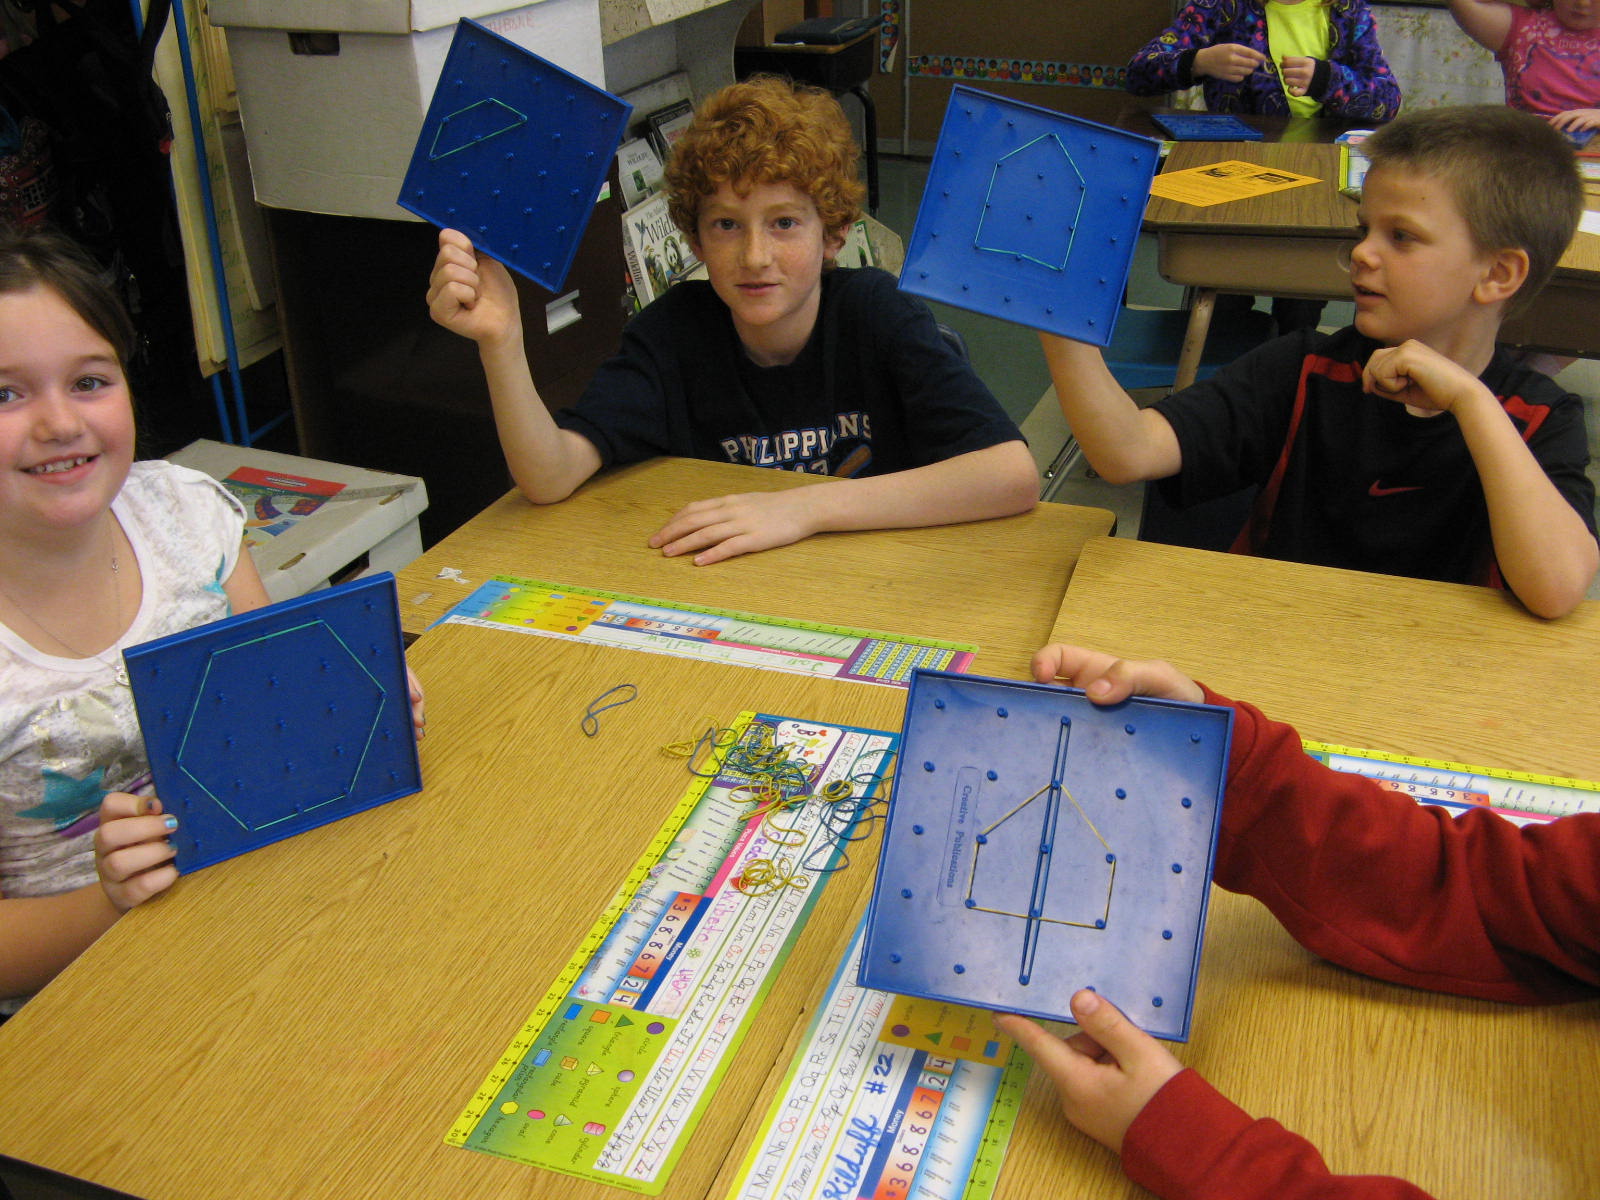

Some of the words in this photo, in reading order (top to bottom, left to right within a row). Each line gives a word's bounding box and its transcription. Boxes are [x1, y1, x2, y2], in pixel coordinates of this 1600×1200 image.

[957, 785, 972, 825] Creative
[739, 828, 752, 841] Place
[728, 842, 743, 857] Values
[947, 830, 966, 889] Publications
[664, 941, 683, 960] Money
[819, 1030, 838, 1045] Ss
[809, 1050, 828, 1065] Rr
[799, 1069, 826, 1088] Qq
[566, 1079, 592, 1106] pyramid
[787, 1093, 815, 1111] Pp
[885, 1109, 906, 1132] Money
[764, 1140, 788, 1157] Nn
[823, 1113, 881, 1200] Kilduff
[750, 1165, 777, 1187] Mm
